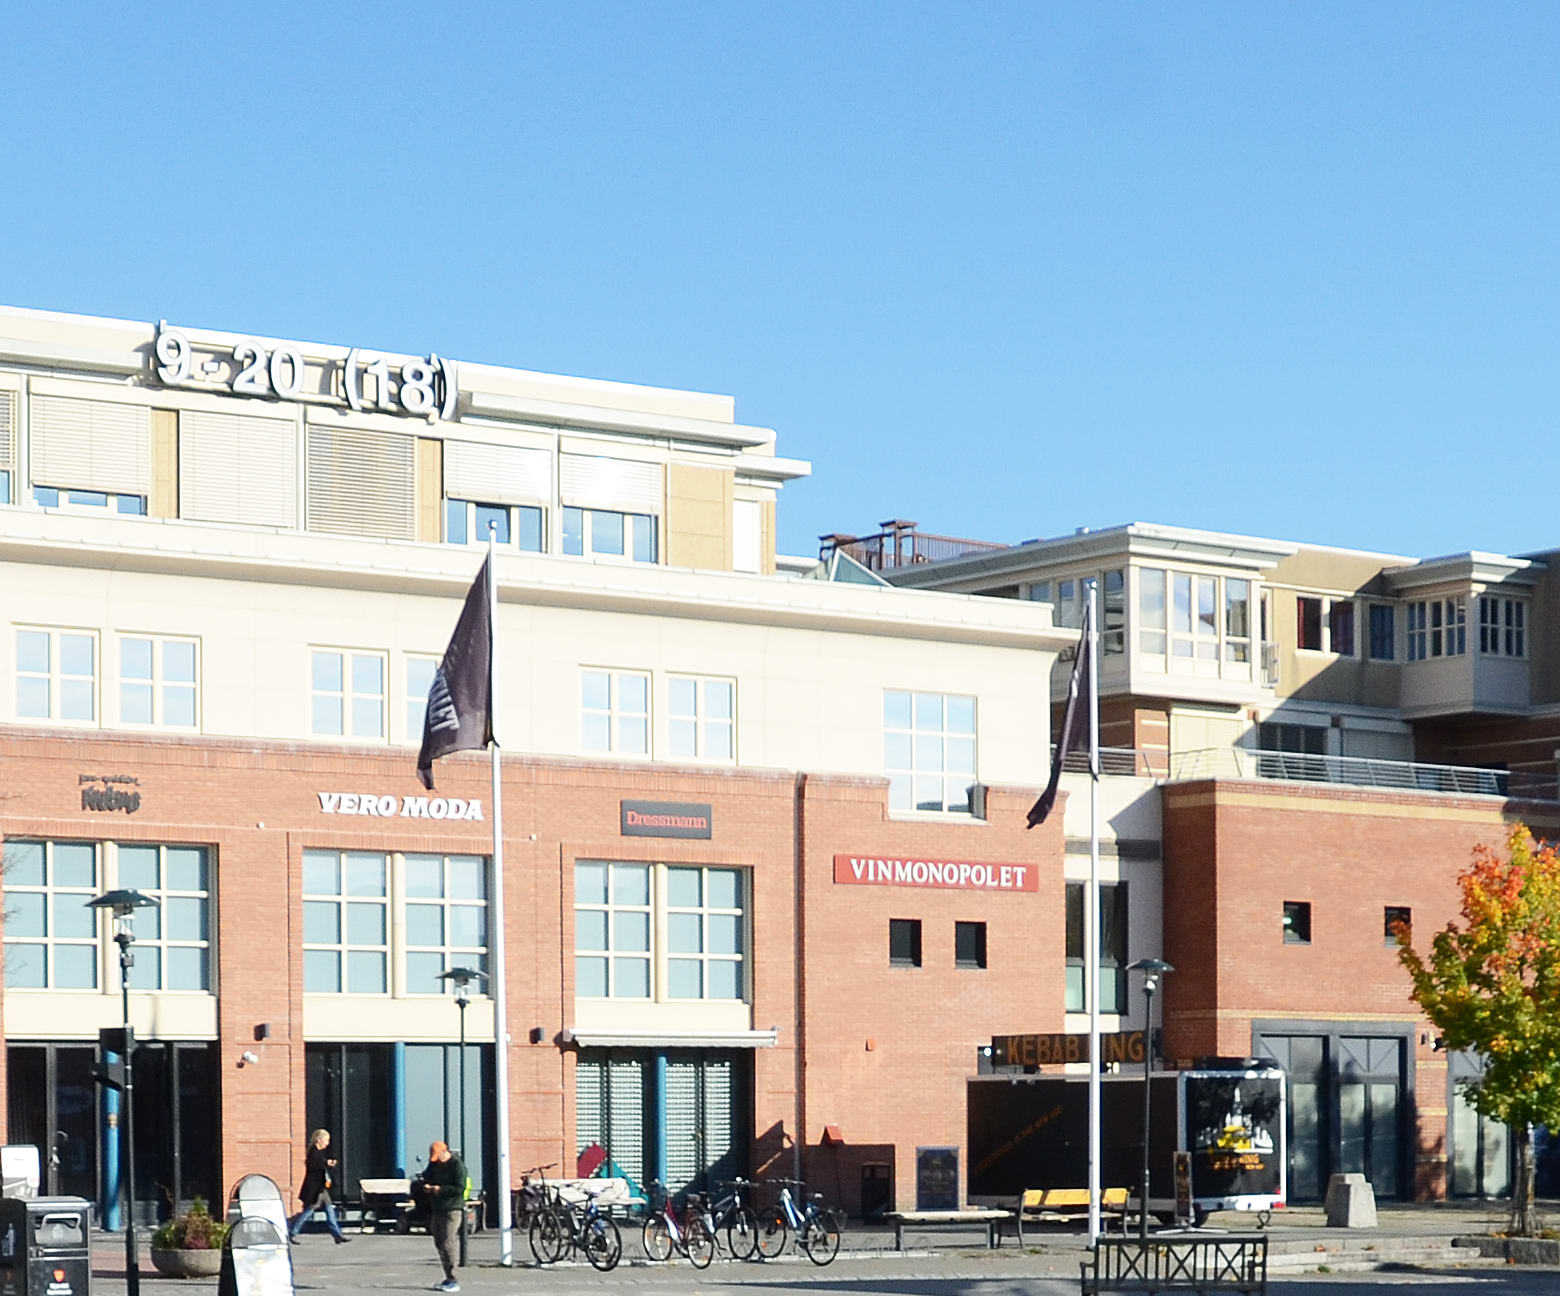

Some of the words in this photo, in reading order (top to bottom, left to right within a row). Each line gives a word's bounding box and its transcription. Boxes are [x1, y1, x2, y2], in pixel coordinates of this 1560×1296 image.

[345, 347, 457, 420] (18)
[318, 792, 397, 817] VERO
[400, 796, 484, 821] MODA
[627, 810, 707, 829] Dressmann
[850, 858, 1027, 888] VINMONOPOLET
[1007, 1033, 1081, 1065] KEBAB
